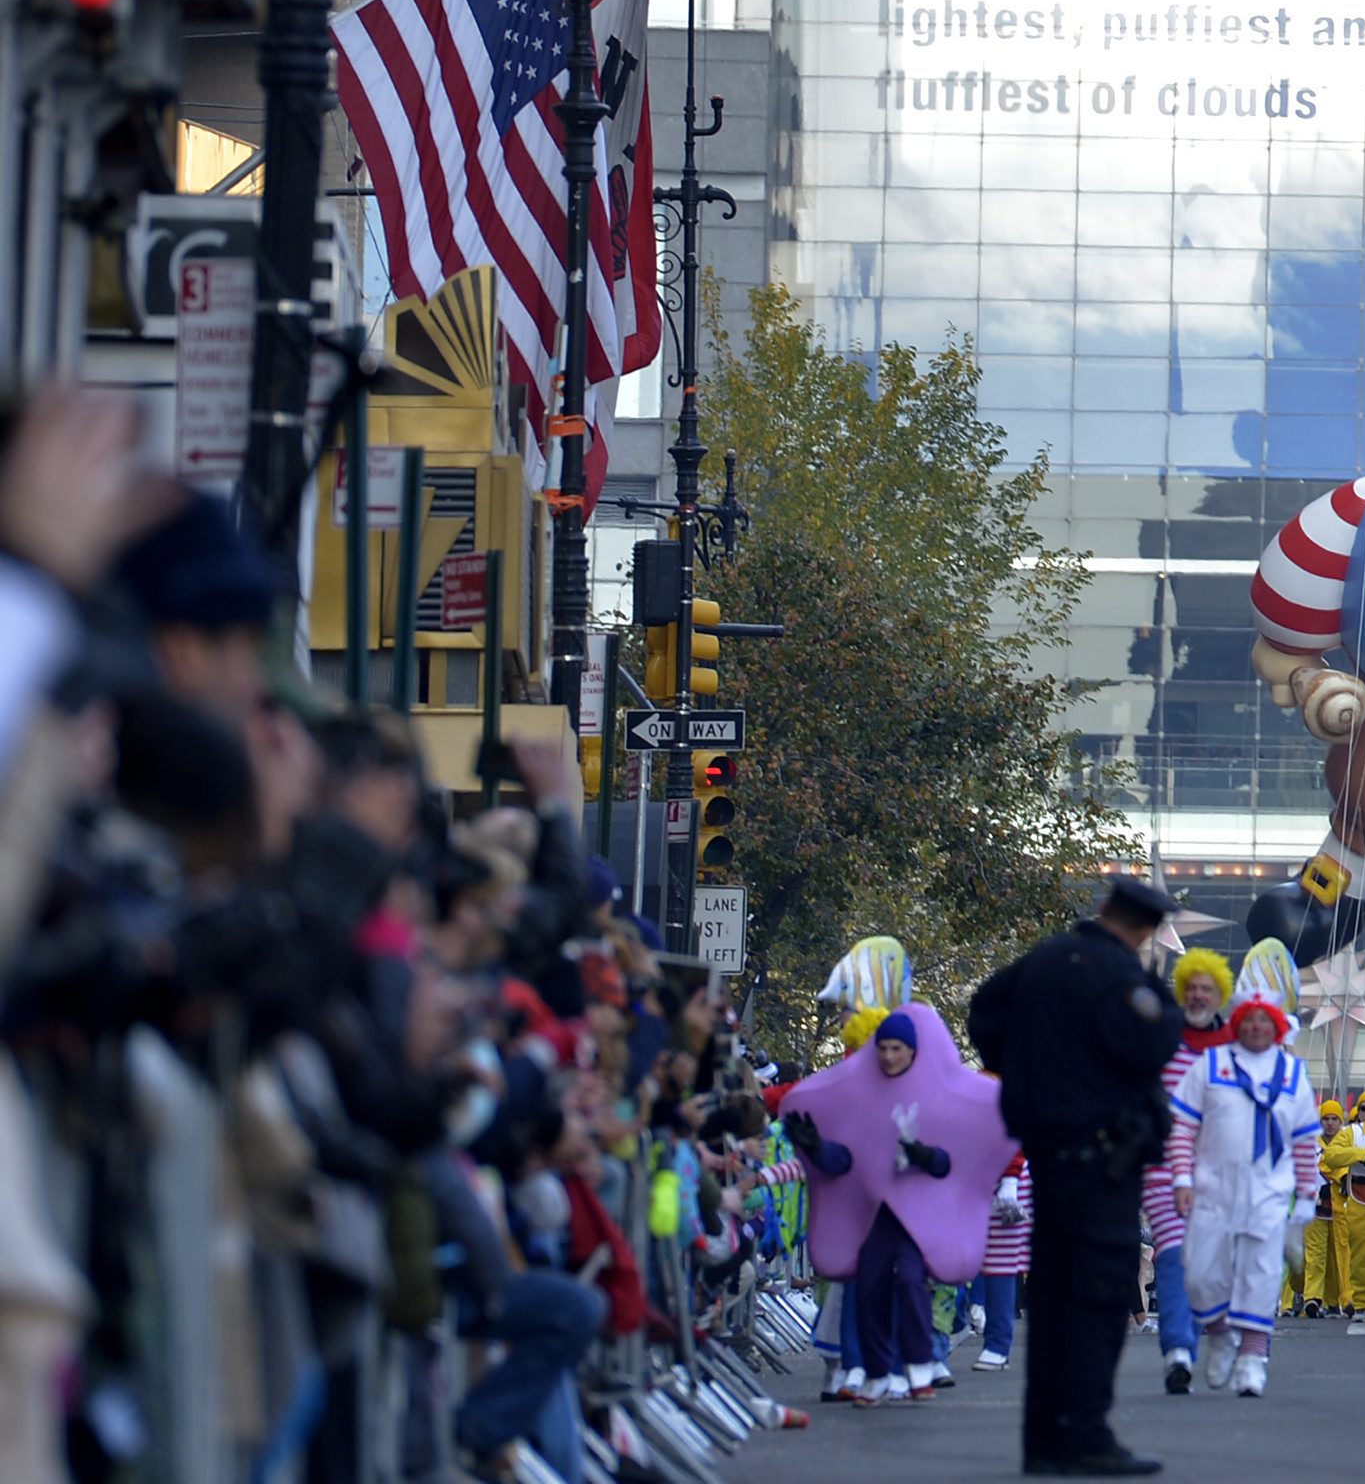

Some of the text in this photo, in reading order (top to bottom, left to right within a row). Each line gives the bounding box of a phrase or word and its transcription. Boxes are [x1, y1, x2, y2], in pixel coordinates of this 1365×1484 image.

[1103, 3, 1292, 51] puffiest
[874, 69, 1318, 120] fluffiest of clouds
[648, 722, 728, 738] ON WAY
[705, 898, 738, 912] LANE
[699, 921, 724, 938] ST
[706, 948, 737, 963] LEFT
